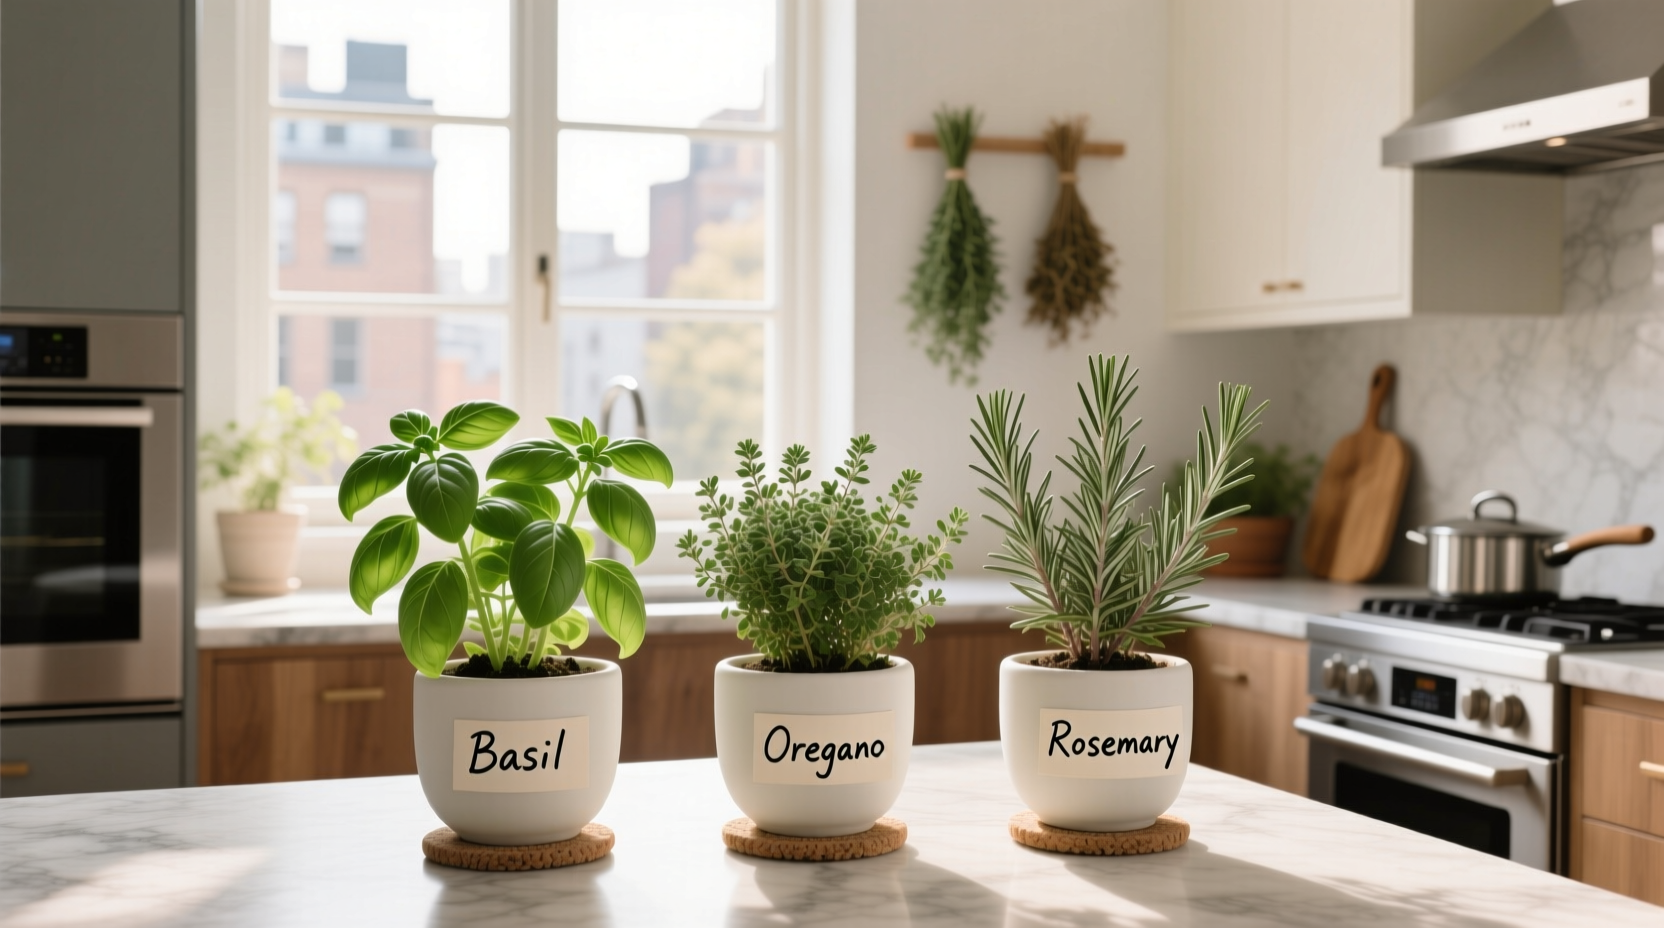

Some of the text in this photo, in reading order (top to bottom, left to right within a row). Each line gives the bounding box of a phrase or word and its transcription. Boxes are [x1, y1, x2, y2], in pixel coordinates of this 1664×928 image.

[468, 728, 566, 775] Basil
[763, 724, 885, 780] Oregano
[1048, 719, 1180, 770] Rosemary
